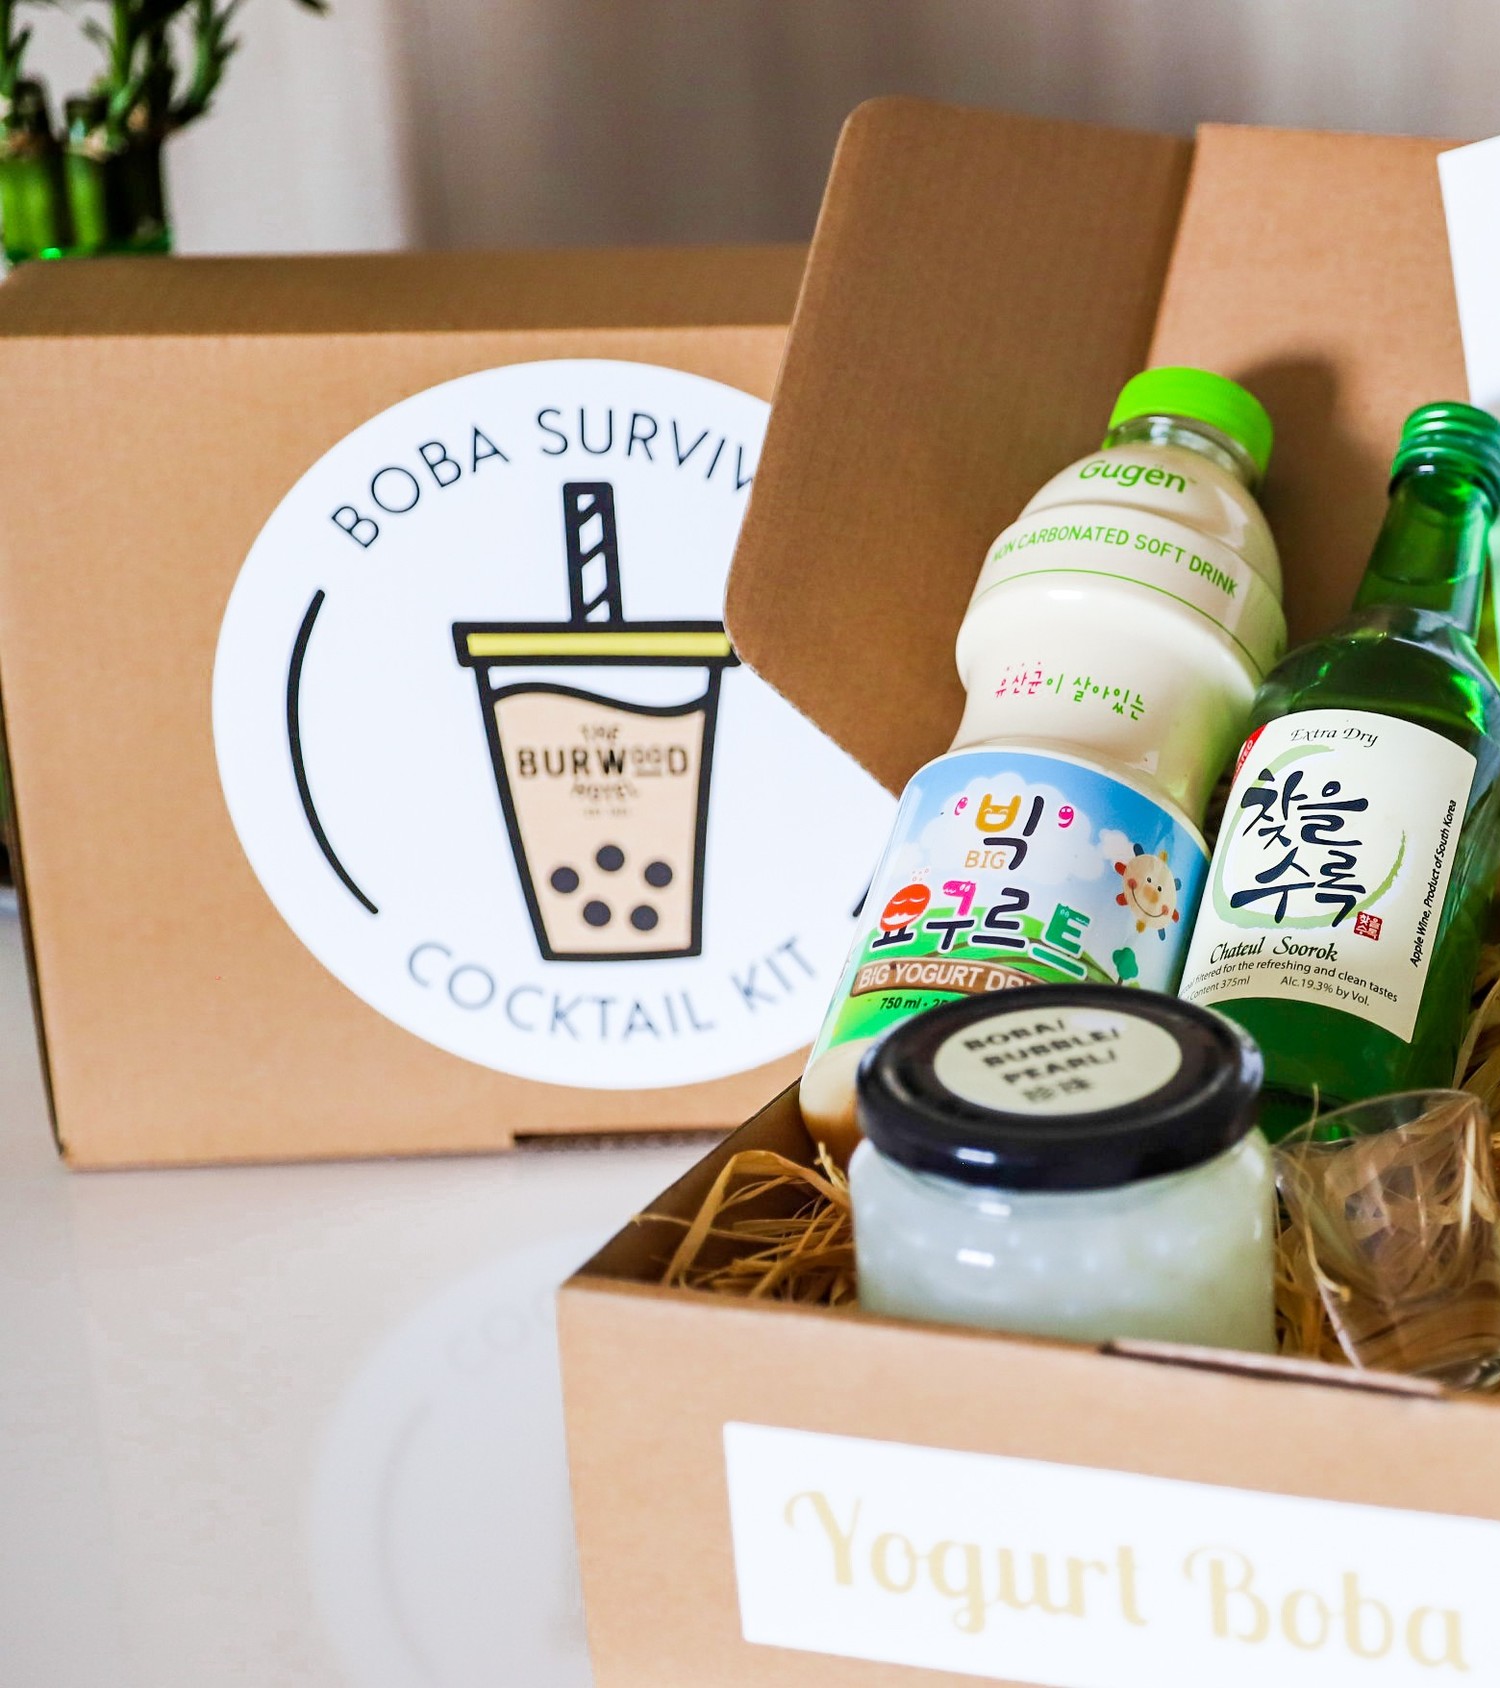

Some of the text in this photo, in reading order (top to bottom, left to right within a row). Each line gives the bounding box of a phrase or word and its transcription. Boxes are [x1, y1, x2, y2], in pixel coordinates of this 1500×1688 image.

[332, 407, 753, 548] BOBA SURVIV
[1017, 525, 1129, 551] CARBONATED
[1134, 534, 1186, 564] SOFT
[1189, 555, 1238, 598] DRINK
[1073, 676, 1145, 720] 살아있는
[1290, 728, 1378, 748] Extra Dry
[517, 746, 688, 777] BURWOOD
[1241, 768, 1369, 850] 찾을
[964, 850, 1006, 869] BIG
[1230, 847, 1367, 928] 수록
[1410, 799, 1457, 968] Apple Wine, Product of South Korea
[1210, 936, 1338, 965] Chateul Soorok
[407, 937, 818, 1041] COCKTAIL KIT
[858, 965, 891, 989] BIG
[894, 963, 984, 988] YOGURT
[1190, 982, 1220, 1001] Content
[1221, 976, 1251, 989] 375ml
[1336, 985, 1350, 999] by
[1352, 990, 1370, 1006] Vol.
[1195, 959, 1398, 1003] filtered for the refreshing and clean tastes
[880, 997, 902, 1010] 750
[904, 997, 922, 1009] ml
[783, 1490, 1149, 1635] Yogurt
[1181, 1543, 1472, 1661] Boba
